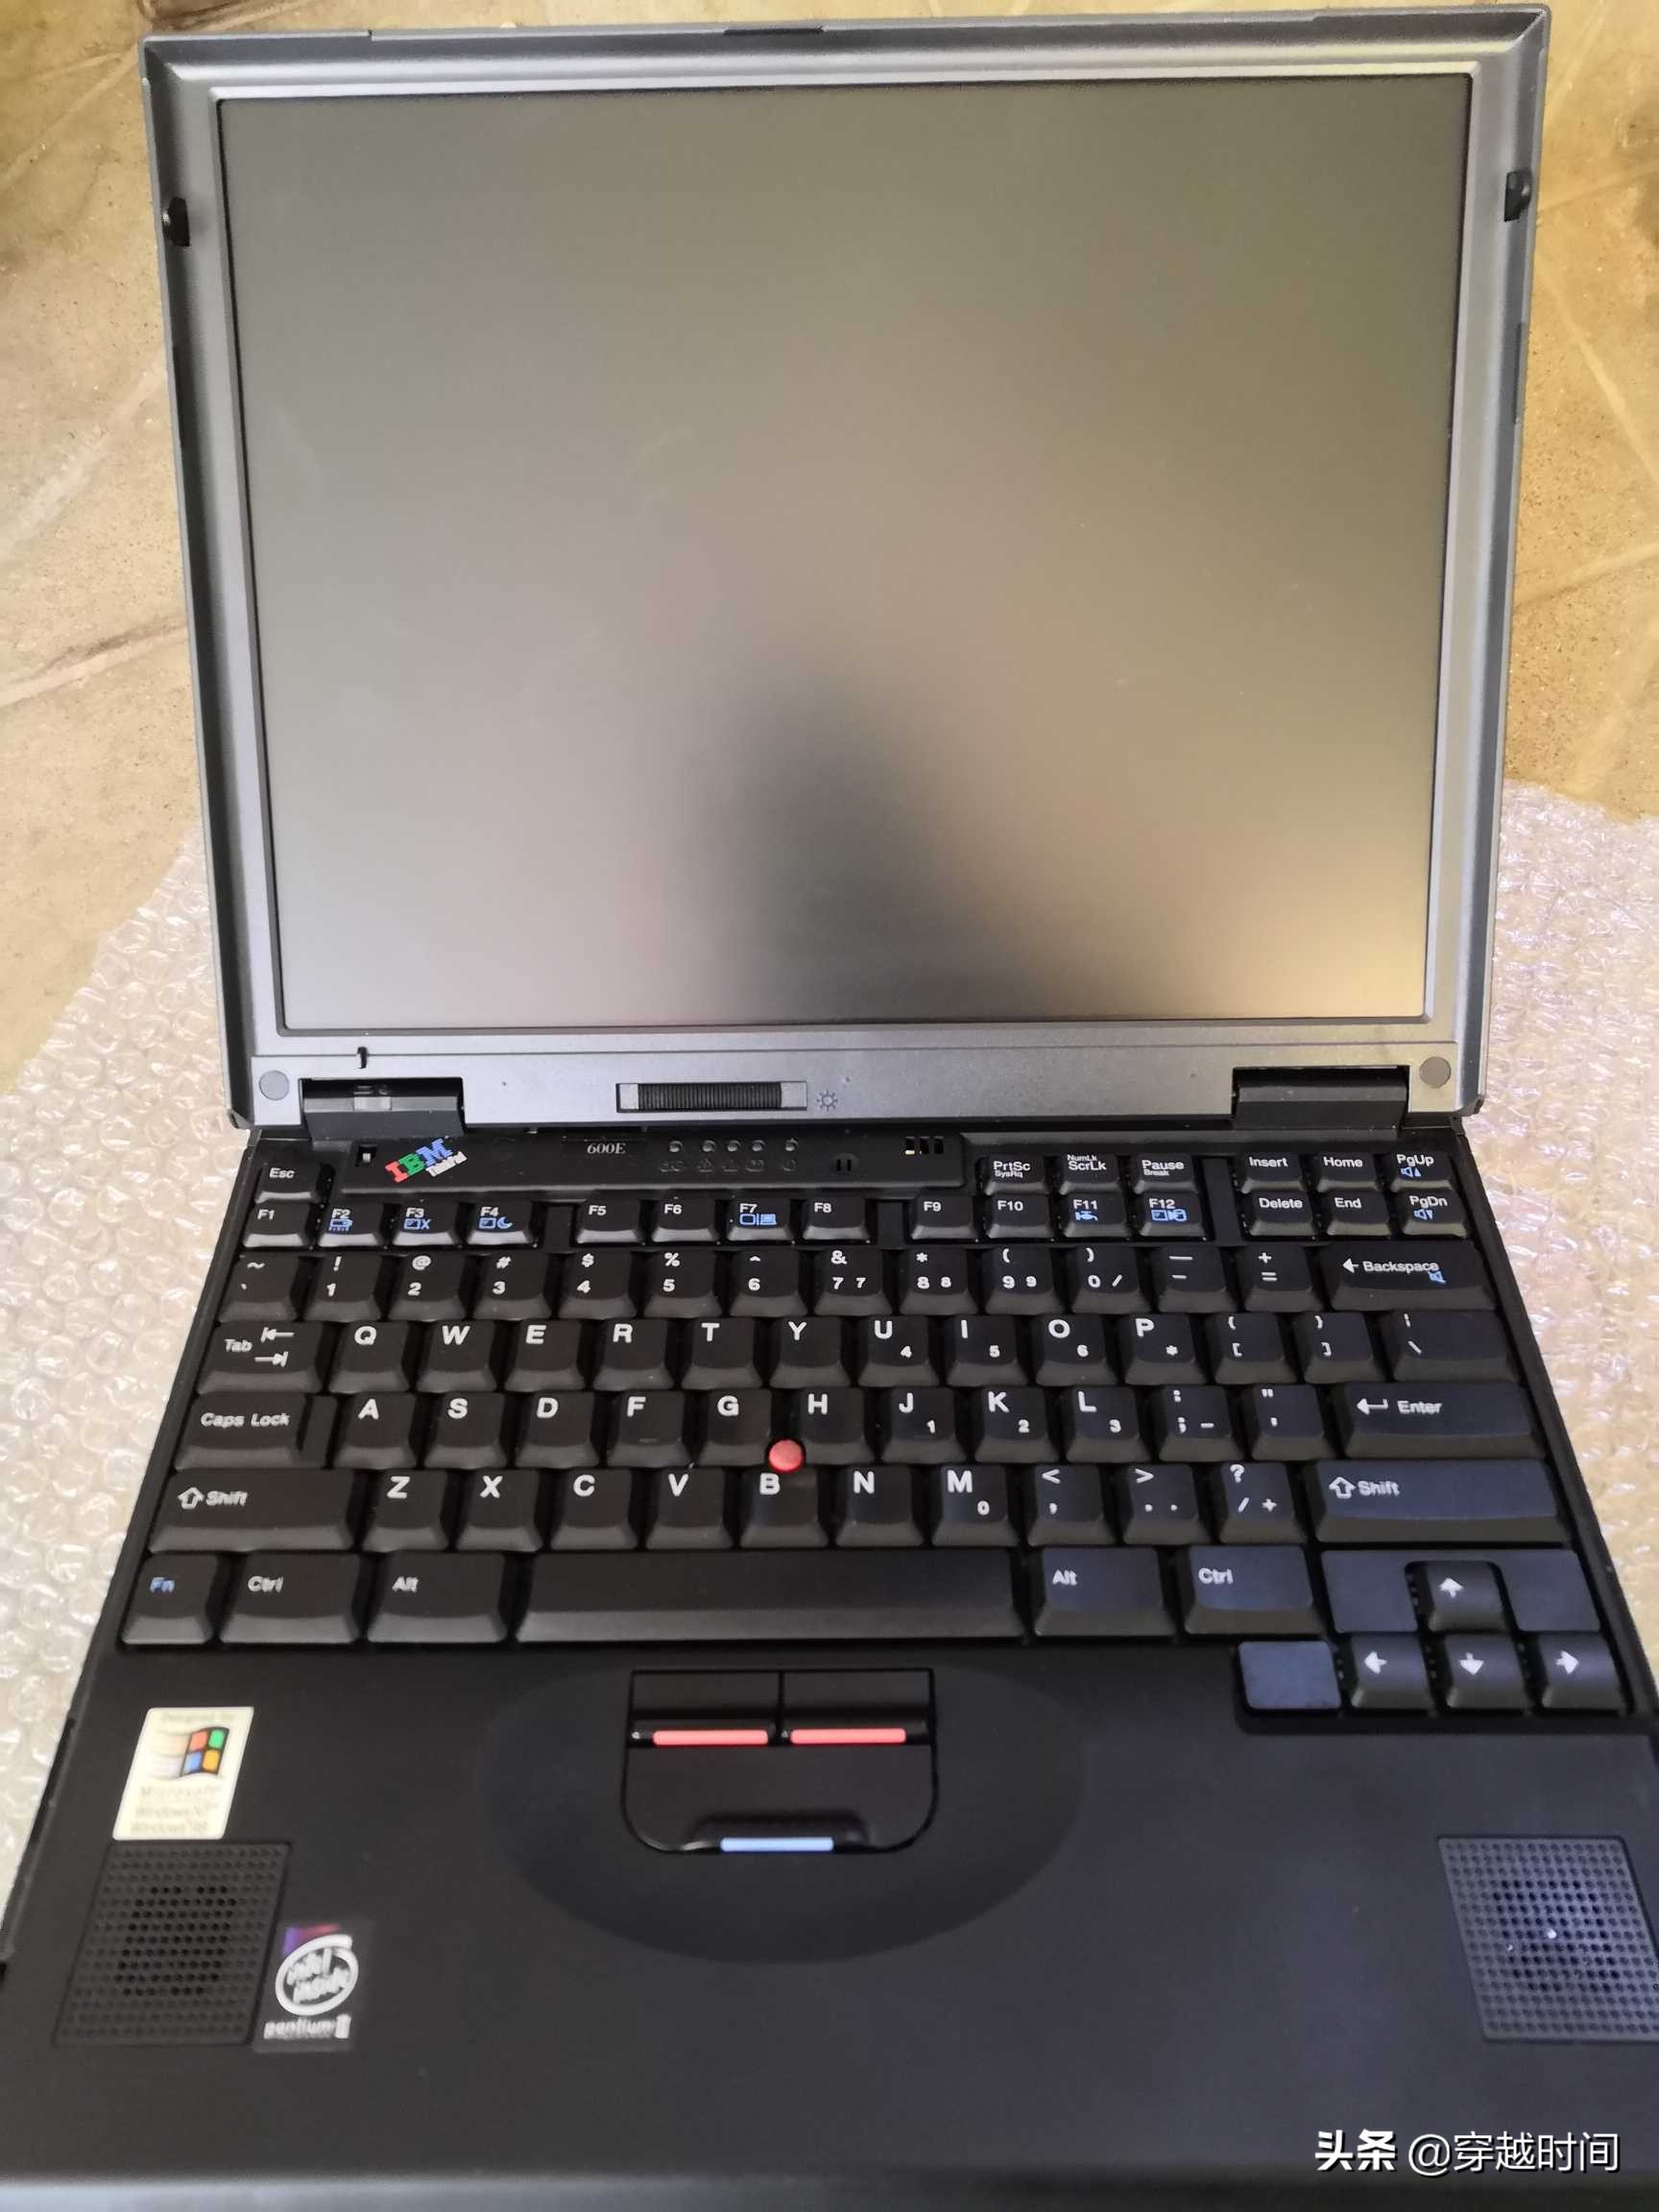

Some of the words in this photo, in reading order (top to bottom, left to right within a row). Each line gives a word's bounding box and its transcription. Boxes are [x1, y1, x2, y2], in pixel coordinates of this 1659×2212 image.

[588, 1143, 625, 1153] 600E
[385, 1139, 454, 1183] IBM
[994, 1161, 1030, 1170] PrtSc
[1069, 1160, 1106, 1170] ScrLk
[1142, 1160, 1184, 1171] Pause
[1249, 1157, 1287, 1166] Insert
[1324, 1157, 1362, 1166] Home
[1397, 1154, 1433, 1168] PgUp
[270, 1167, 295, 1178] Esc
[664, 1204, 682, 1214] F6
[740, 1204, 757, 1214] F7
[814, 1203, 831, 1213] F8
[924, 1201, 941, 1212] F9
[998, 1200, 1022, 1211] F10
[1073, 1199, 1097, 1210] F11
[1149, 1198, 1177, 1210] F12
[1259, 1198, 1302, 1208] Delete
[1334, 1198, 1361, 1208] End
[1409, 1196, 1447, 1211] PgDn
[258, 1210, 274, 1219] F1
[332, 1209, 349, 1219] F2
[406, 1208, 423, 1218] F3
[481, 1207, 498, 1216] F4
[589, 1205, 606, 1215] F5
[413, 1256, 431, 1270] @
[496, 1257, 511, 1268] #
[582, 1254, 593, 1267] $
[665, 1253, 680, 1266] %
[831, 1250, 847, 1264] &
[1363, 1262, 1439, 1272] Backspace
[493, 1282, 505, 1294] 3
[577, 1281, 590, 1293] 4
[663, 1279, 675, 1291] 5
[749, 1278, 759, 1290] 6
[833, 1277, 843, 1289] 7
[856, 1278, 866, 1287] 7
[918, 1277, 929, 1288] 8
[941, 1277, 951, 1287] 8
[1003, 1276, 1015, 1288] 9
[1026, 1276, 1036, 1286] 9
[327, 1284, 336, 1296] 1
[408, 1283, 421, 1295] 2
[613, 1324, 633, 1342] R
[702, 1323, 719, 1341] T
[789, 1322, 806, 1340] Y
[875, 1320, 892, 1338] U
[961, 1320, 968, 1338] I
[1048, 1319, 1070, 1337] O
[1136, 1318, 1154, 1336] P
[354, 1326, 376, 1345] Q
[443, 1326, 469, 1344] W
[526, 1325, 546, 1344] E
[225, 1339, 252, 1352] Tab
[901, 1346, 911, 1358] 4
[990, 1345, 999, 1358] 5
[1077, 1345, 1088, 1357] 6
[628, 1397, 646, 1416] F
[717, 1396, 738, 1416] G
[808, 1394, 828, 1414] H
[900, 1393, 913, 1412] J
[989, 1391, 1009, 1412] K
[1078, 1391, 1096, 1411] L
[1398, 1401, 1442, 1414] Enter
[358, 1399, 378, 1419] A
[448, 1399, 468, 1418] S
[537, 1398, 558, 1418] D
[201, 1413, 244, 1428] Caps
[252, 1413, 289, 1427] Lock
[927, 1420, 935, 1432] 1
[1019, 1420, 1029, 1432] 2
[1110, 1420, 1121, 1432] 3
[1043, 1470, 1060, 1483] <
[1136, 1469, 1153, 1482] >
[1231, 1464, 1244, 1482] ?
[480, 1476, 502, 1498] X
[574, 1475, 594, 1496] C
[668, 1474, 688, 1496] V
[760, 1471, 782, 1495] B
[854, 1471, 874, 1494] N
[948, 1470, 973, 1492] M
[387, 1477, 410, 1499] Z
[1358, 1481, 1400, 1495] Shift
[206, 1491, 248, 1505] Shift
[1053, 1571, 1077, 1585] Alt
[1199, 1568, 1233, 1584] Ctrl
[248, 1576, 283, 1592] Ctrl
[393, 1577, 418, 1592] Alt
